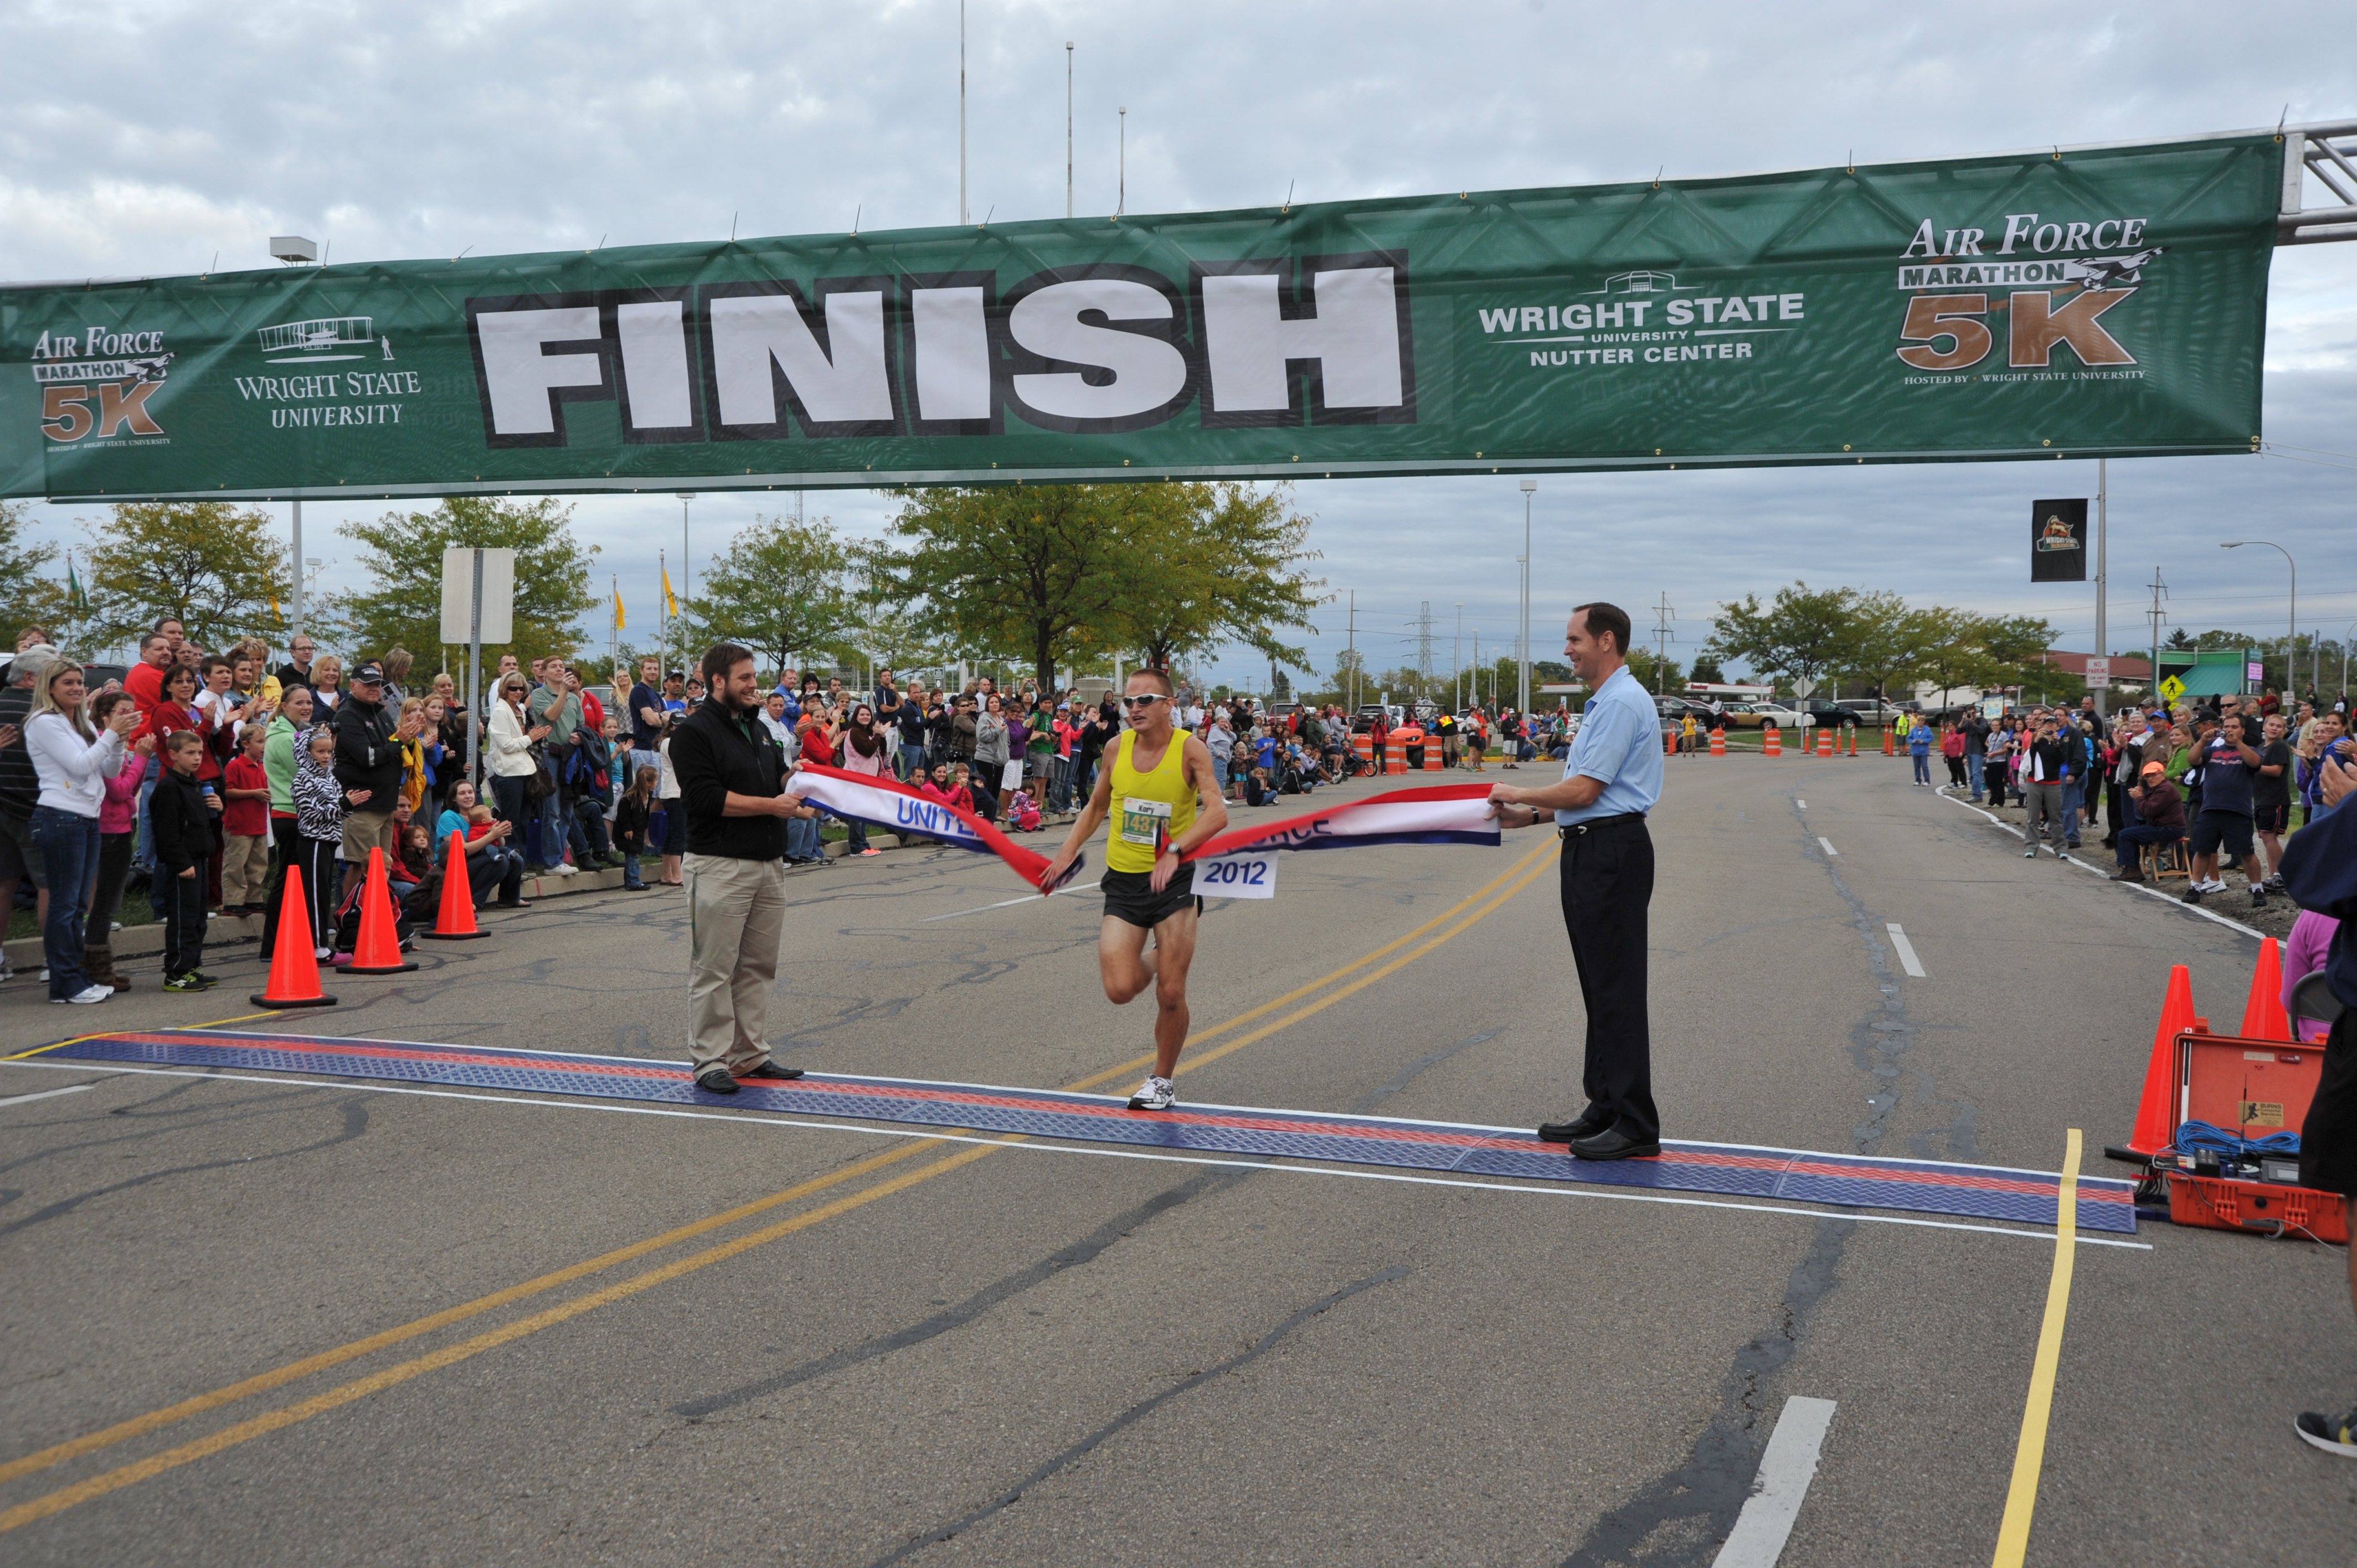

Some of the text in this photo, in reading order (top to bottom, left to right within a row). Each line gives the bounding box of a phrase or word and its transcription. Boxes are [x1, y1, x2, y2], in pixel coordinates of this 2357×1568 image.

[1899, 213, 2147, 259] AIR FORCE
[1903, 263, 2065, 286] MARATHON
[1479, 293, 1804, 333] WRIGHT STATE
[1591, 331, 1689, 343] UNIVERSITY
[1896, 287, 2139, 370] 5K
[31, 327, 163, 359] AIR FORCE
[471, 262, 1408, 440] FINISH
[1530, 343, 1752, 366] NUTTER CENTER
[37, 363, 126, 379] MARATHON
[1905, 370, 2146, 384] HOSTED BY WRIGHT STATE UNIVERSITY
[234, 371, 421, 402] WRIGHT STATE
[41, 380, 166, 442] 5K
[271, 404, 403, 428] UNIVERSITY
[128, 438, 171, 446] UNIVERSITY
[1138, 804, 1155, 814] Kory
[1203, 860, 1267, 885] 2012
